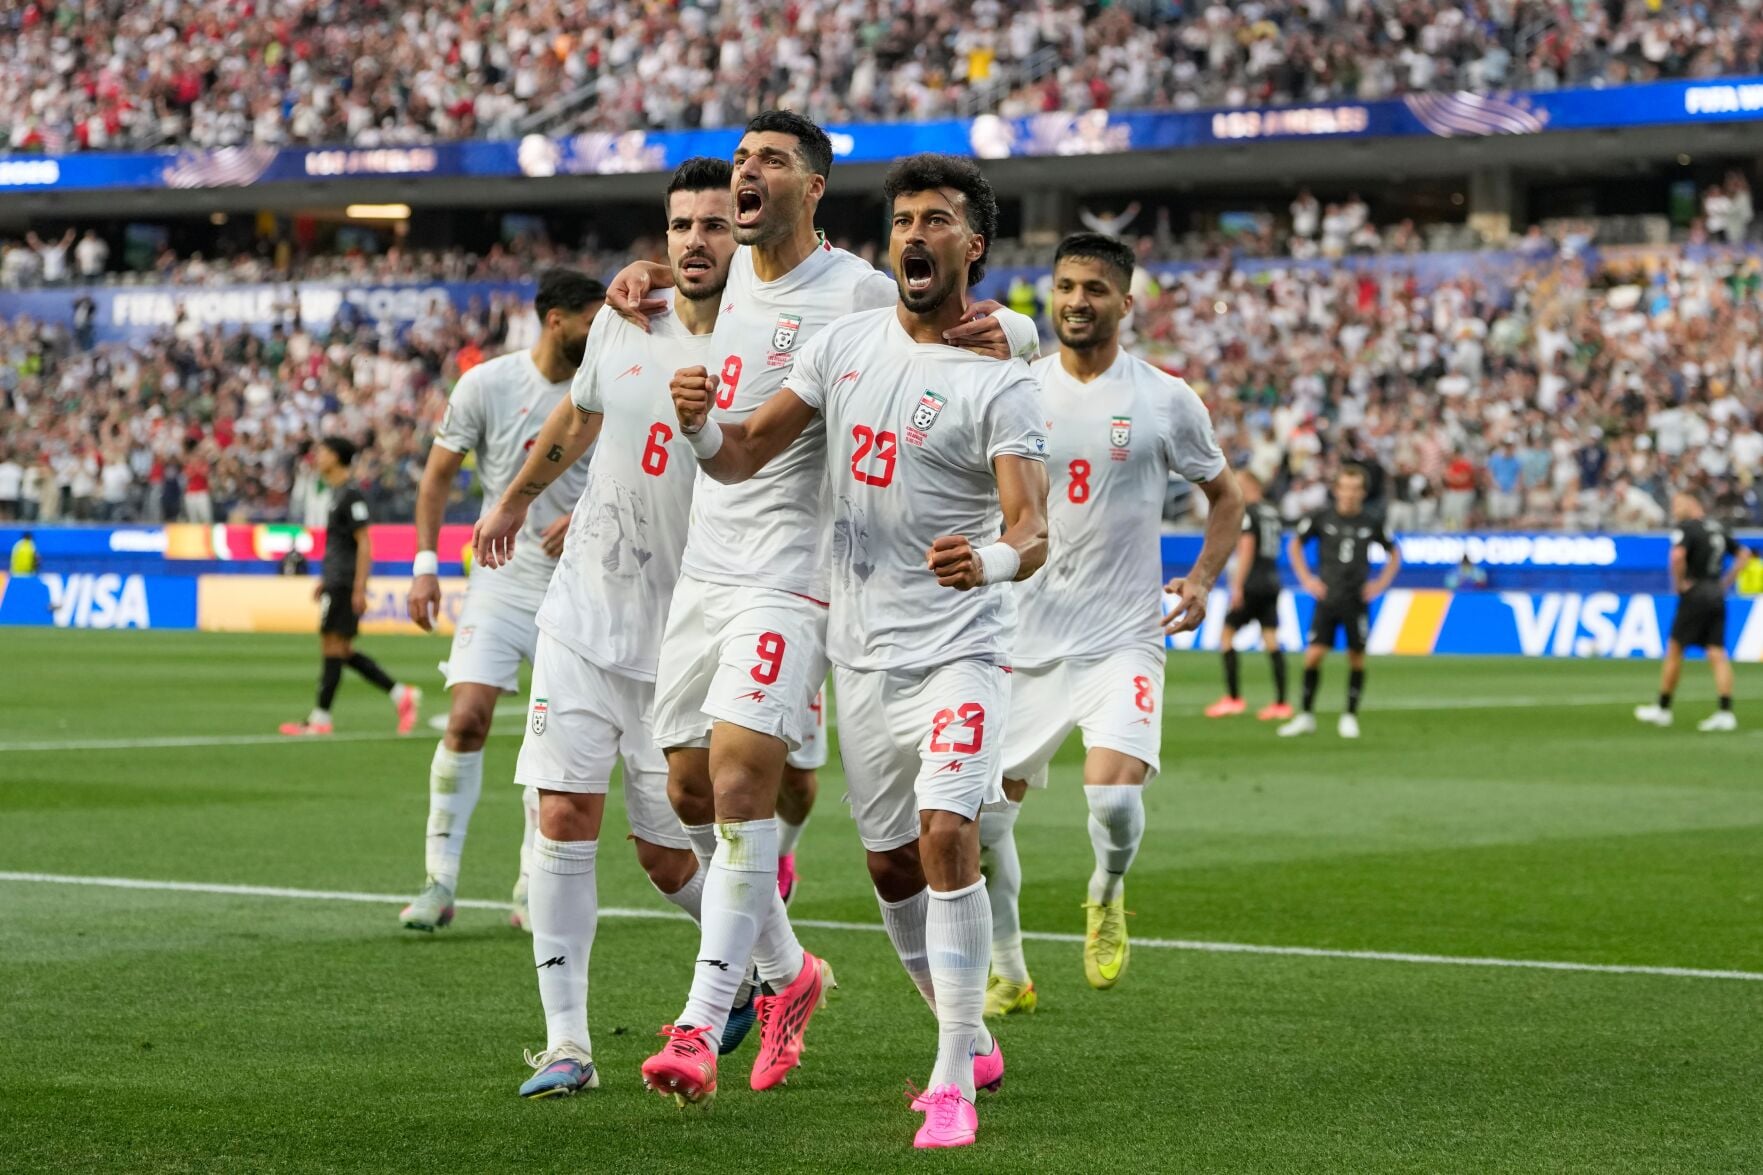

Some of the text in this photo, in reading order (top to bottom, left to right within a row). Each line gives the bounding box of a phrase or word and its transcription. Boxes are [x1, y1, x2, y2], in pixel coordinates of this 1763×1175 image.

[715, 354, 743, 410] 9
[641, 421, 673, 477] 6
[851, 424, 897, 488] 23
[1067, 459, 1091, 504] 8
[39, 573, 150, 629] VISA
[1500, 591, 1664, 658] VISA
[751, 631, 786, 685] 9
[1133, 675, 1154, 714] 8
[930, 702, 985, 755] 23
